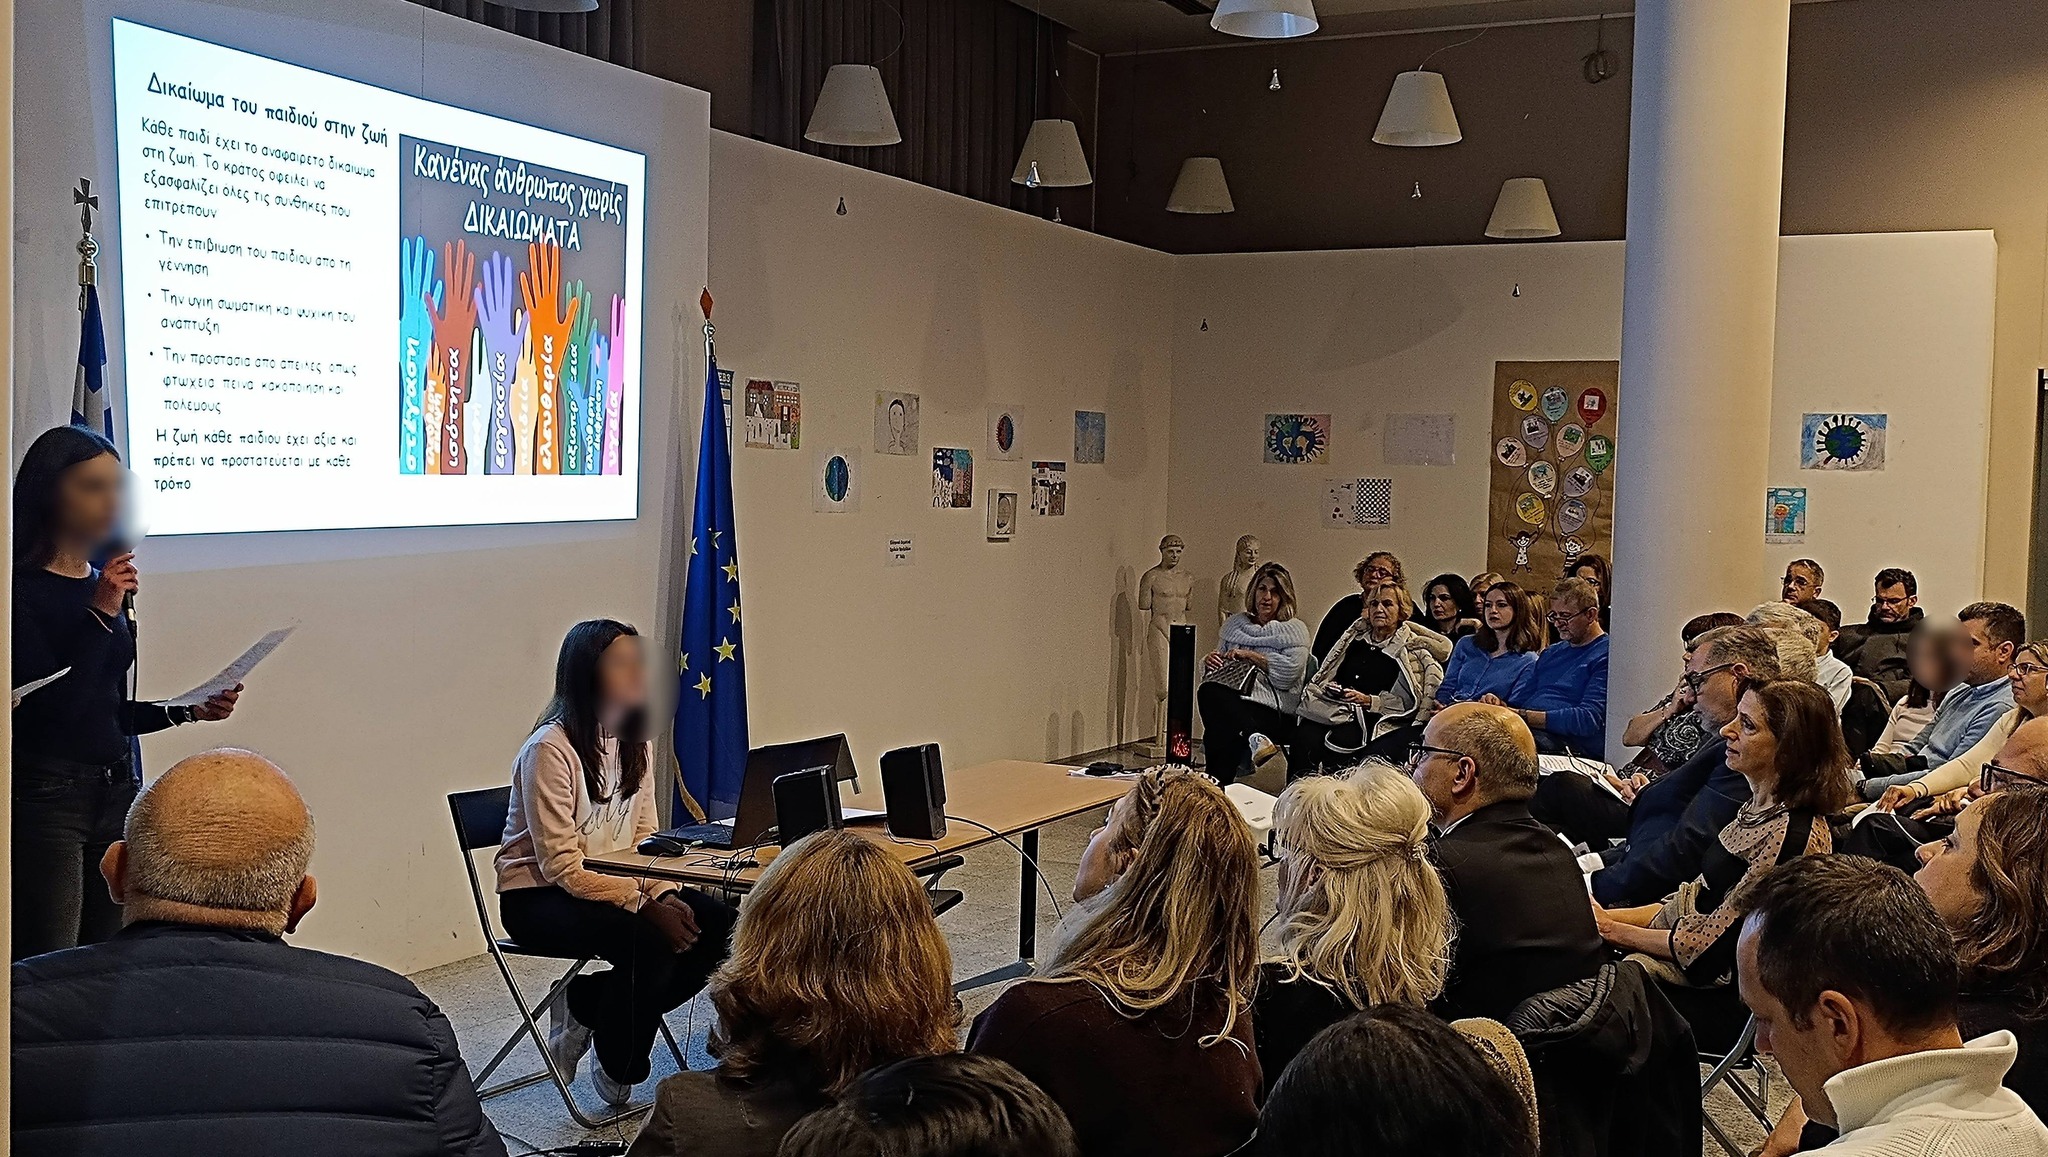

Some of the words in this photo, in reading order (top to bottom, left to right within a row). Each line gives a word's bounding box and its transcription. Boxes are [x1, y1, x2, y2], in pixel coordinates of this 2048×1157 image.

[147, 72, 225, 110] Δικαίωμα
[232, 97, 258, 115] του
[264, 105, 318, 129] παιδιού
[324, 119, 356, 139] στην
[362, 122, 388, 148] ζωή
[141, 116, 174, 138] Κάθε
[179, 128, 210, 145] παιδί
[216, 132, 240, 152] έχει
[244, 142, 258, 154] το
[142, 146, 165, 162] στη
[203, 153, 219, 171] Το
[314, 179, 326, 190] να
[413, 143, 491, 199] Κανένας
[494, 156, 576, 216] άνθρωπος
[578, 181, 623, 226] χωρίς
[222, 182, 250, 204] όλες
[254, 191, 270, 207] τις
[331, 205, 351, 218] που
[463, 200, 581, 252] ΔΙΚΑΙΩΜΑΤΑ
[158, 257, 209, 277] γέννηση
[159, 229, 183, 248] Την
[247, 246, 267, 259] του
[340, 259, 351, 272] τη
[160, 288, 185, 307] Την
[276, 306, 293, 316] και
[337, 311, 356, 323] του
[162, 346, 187, 364] Την
[328, 385, 344, 395] και
[402, 336, 420, 472] στέγαση
[445, 347, 462, 468] ισότητα
[492, 351, 509, 469] εργασία
[539, 334, 556, 470] ελευθερία
[156, 428, 167, 442] Η
[172, 428, 198, 446] ζωή
[341, 436, 357, 446] και
[607, 390, 620, 468] υγεία
[153, 451, 195, 469] πρέπει
[200, 456, 215, 467] να
[308, 457, 321, 468] με
[154, 476, 192, 493] τρόπο
